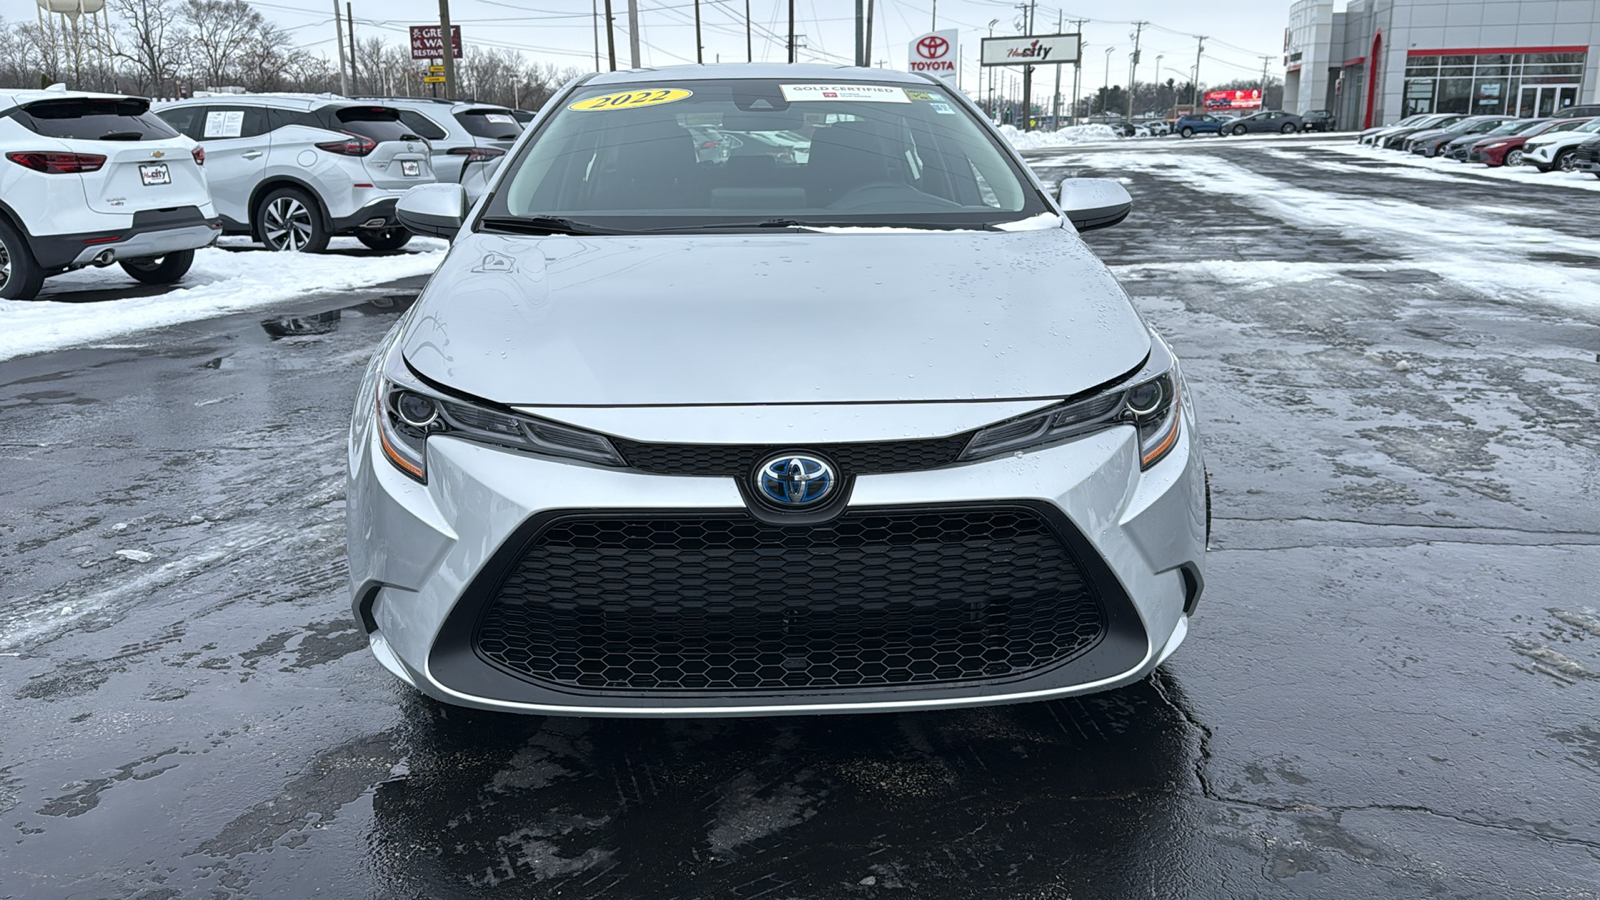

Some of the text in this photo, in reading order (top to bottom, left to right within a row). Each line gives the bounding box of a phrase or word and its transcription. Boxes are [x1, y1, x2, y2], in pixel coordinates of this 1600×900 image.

[422, 28, 456, 38] GRET
[423, 38, 456, 48] WA
[413, 48, 459, 57] RESTAURT
[910, 61, 955, 71] TOYOTA
[588, 90, 671, 110] 2022
